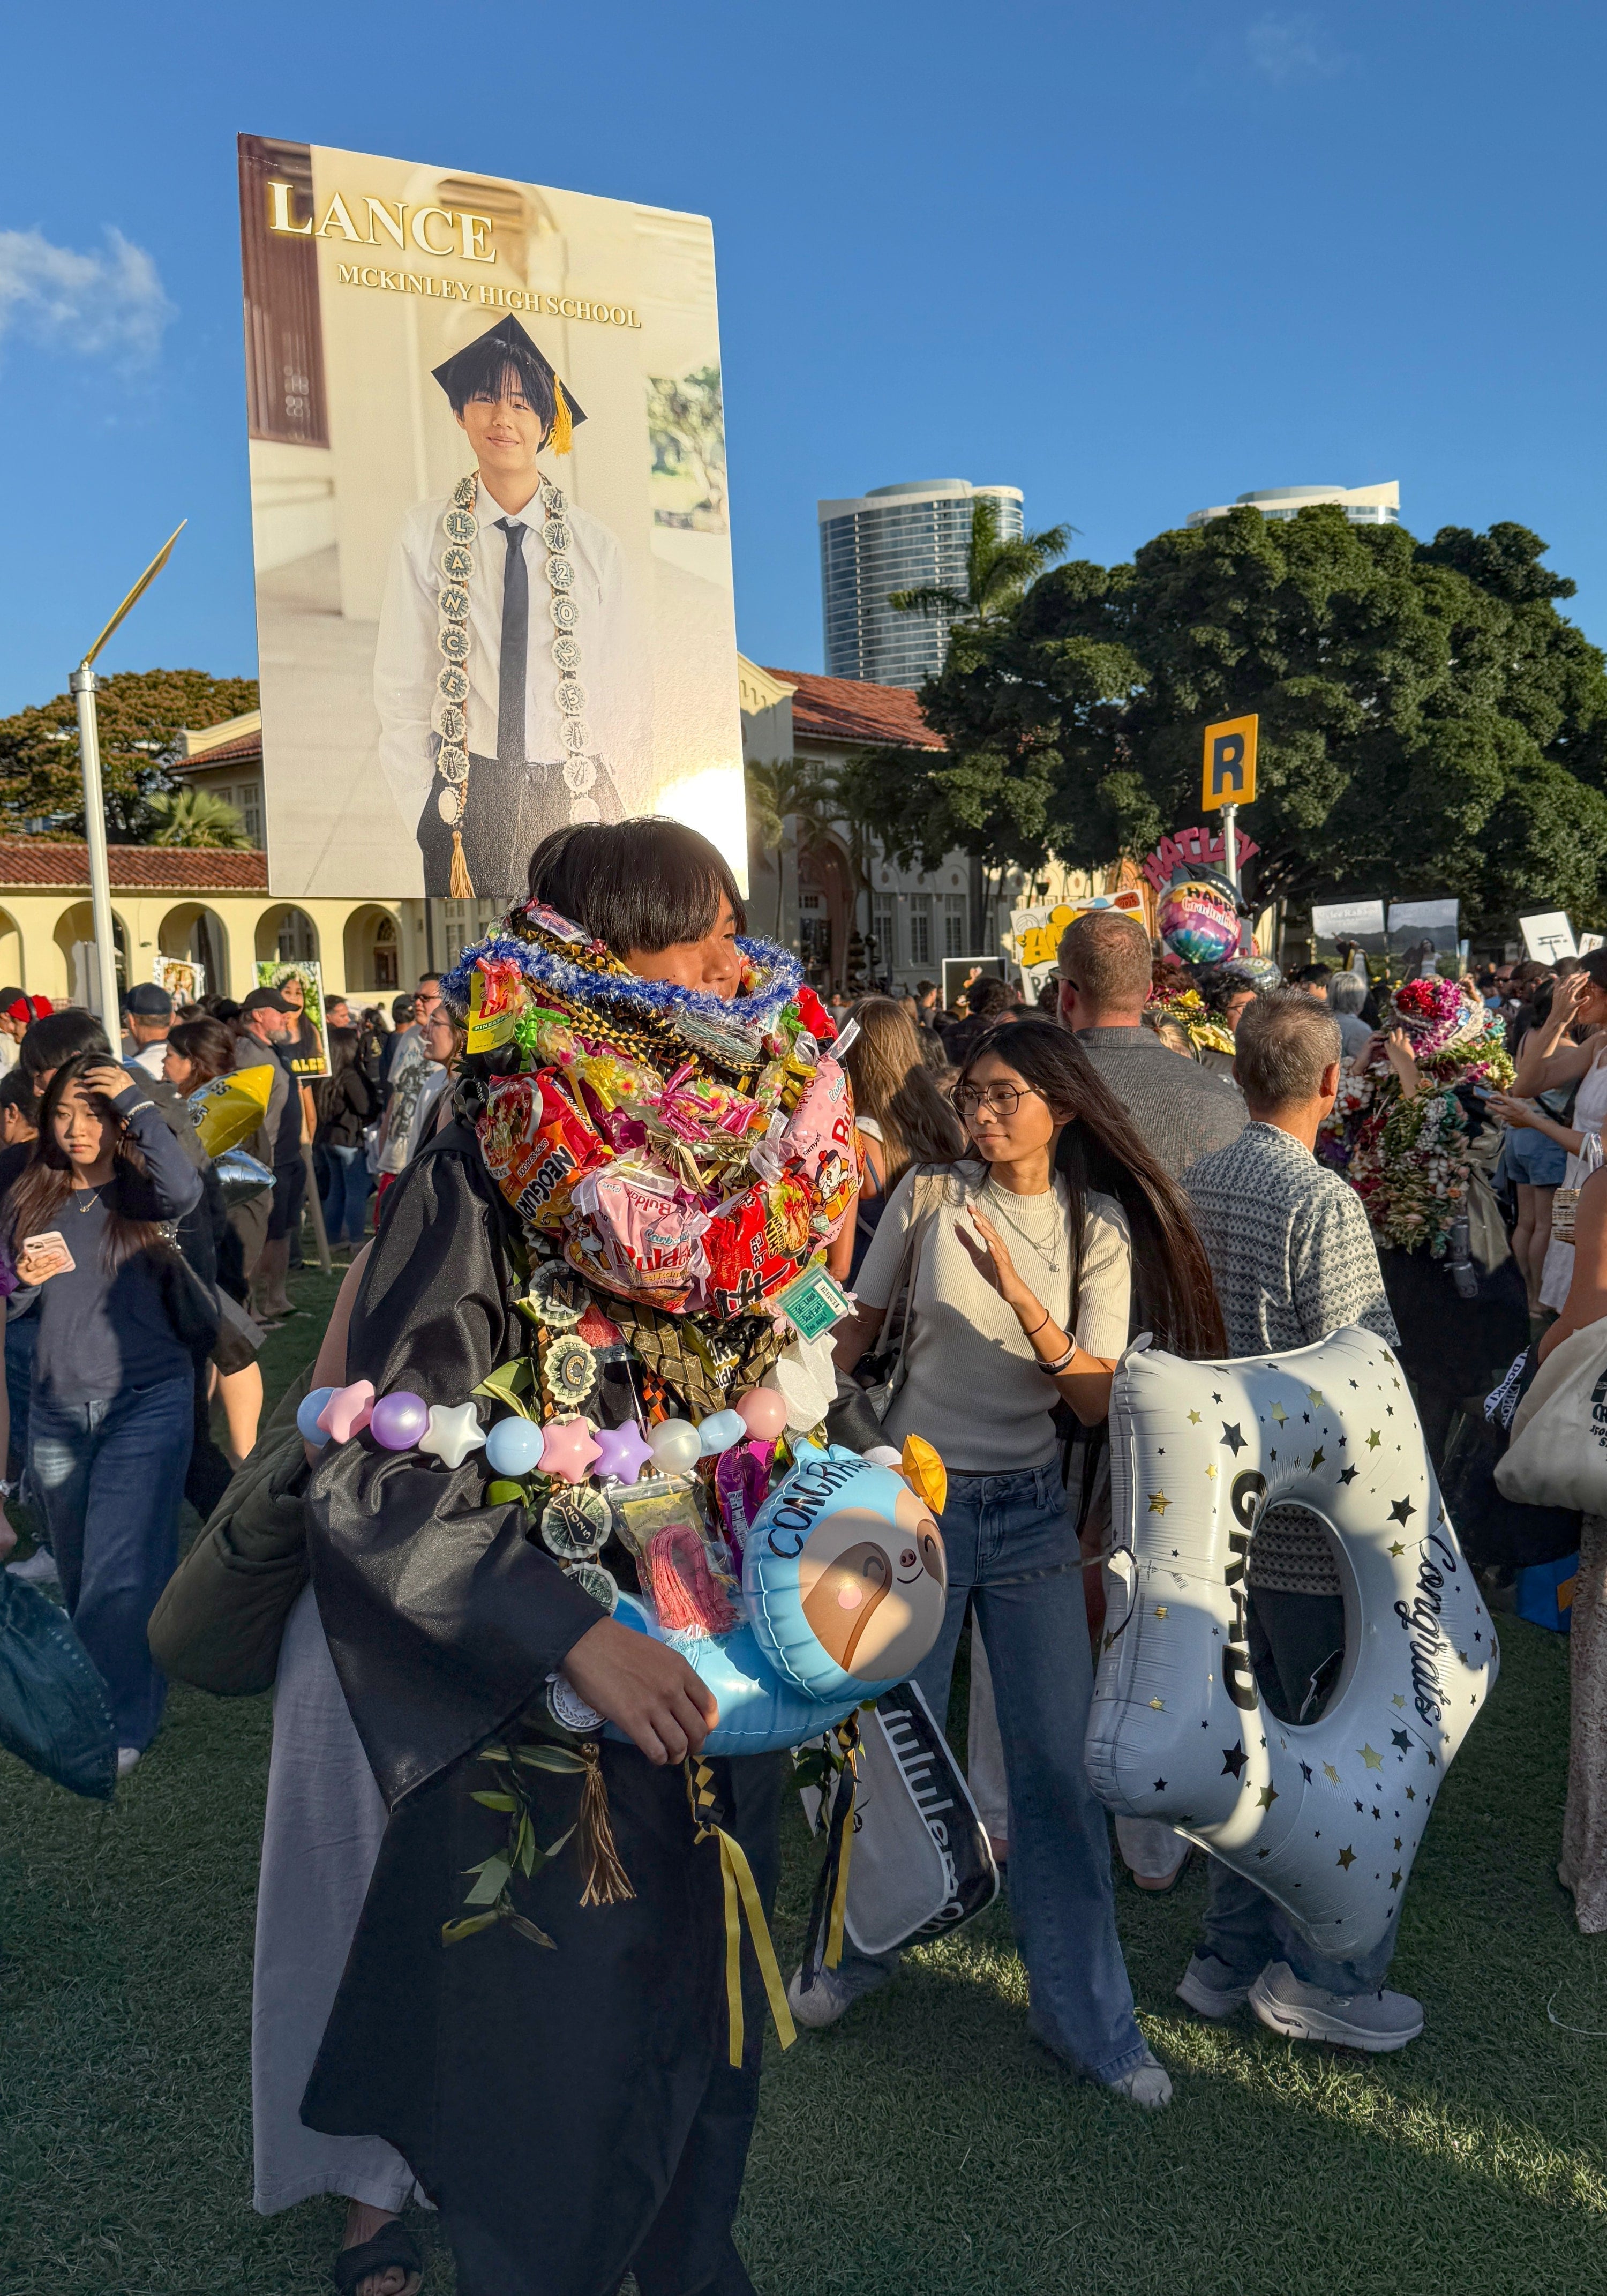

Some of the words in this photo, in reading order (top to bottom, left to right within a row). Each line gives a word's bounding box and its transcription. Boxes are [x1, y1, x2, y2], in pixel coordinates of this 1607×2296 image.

[267, 181, 496, 263] LANCE
[337, 264, 472, 301] MCKINLEY
[478, 285, 542, 312] HIGH
[547, 296, 642, 328] SCHOOL
[1212, 733, 1245, 794] R
[475, 1010, 513, 1030] PINEAPPLE
[517, 1150, 539, 1178] SEAFOOD
[534, 1138, 550, 1158] SPICY
[515, 1144, 579, 1221] NEOGURI
[750, 1232, 768, 1269] 라면
[764, 1222, 780, 1259] SHIN
[772, 1216, 786, 1251] RAMYUN
[1490, 1364, 1522, 1401] DONKI
[1589, 1425, 1607, 1436] 150
[566, 1506, 591, 1539] 2025
[1394, 1534, 1456, 1727] Congrats
